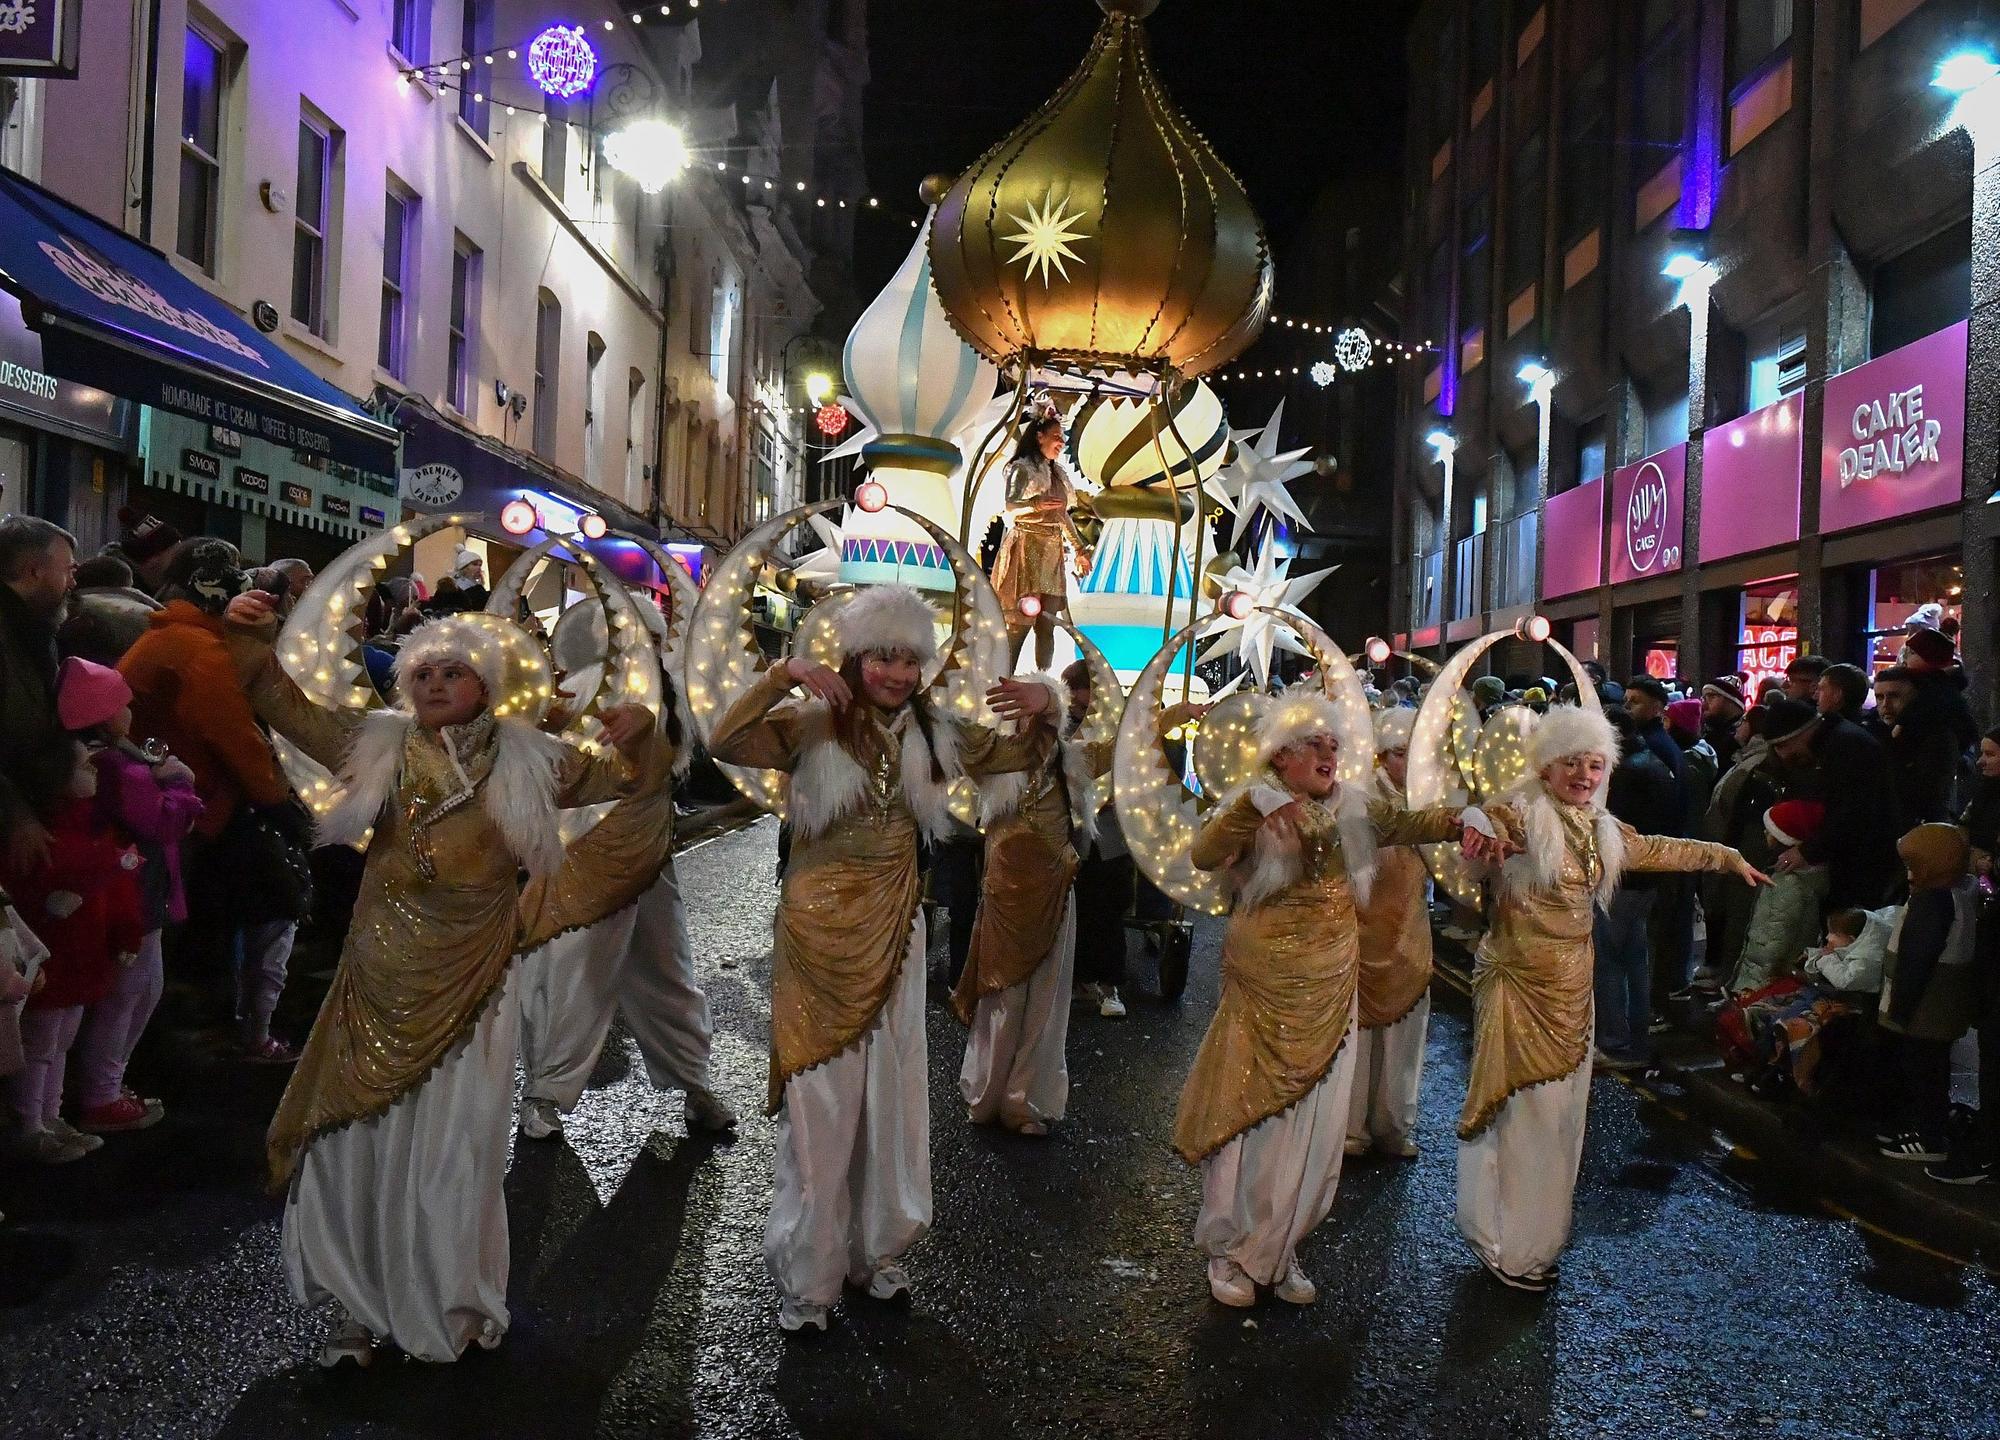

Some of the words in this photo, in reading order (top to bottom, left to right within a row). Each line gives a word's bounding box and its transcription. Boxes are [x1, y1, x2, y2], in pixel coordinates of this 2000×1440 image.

[0, 360, 58, 400] DESSERTS
[162, 383, 211, 417] HOMEMADE
[214, 401, 228, 421] ICE
[262, 416, 287, 440] COFFEE
[298, 428, 331, 453] DESSERTS
[1852, 384, 1923, 440] CAKE
[189, 454, 217, 476] SMOK
[1839, 419, 1941, 488] DEALER
[414, 465, 459, 482] PREMIUM
[414, 487, 459, 505] VAPOURS
[1635, 534, 1656, 552] CAKES
